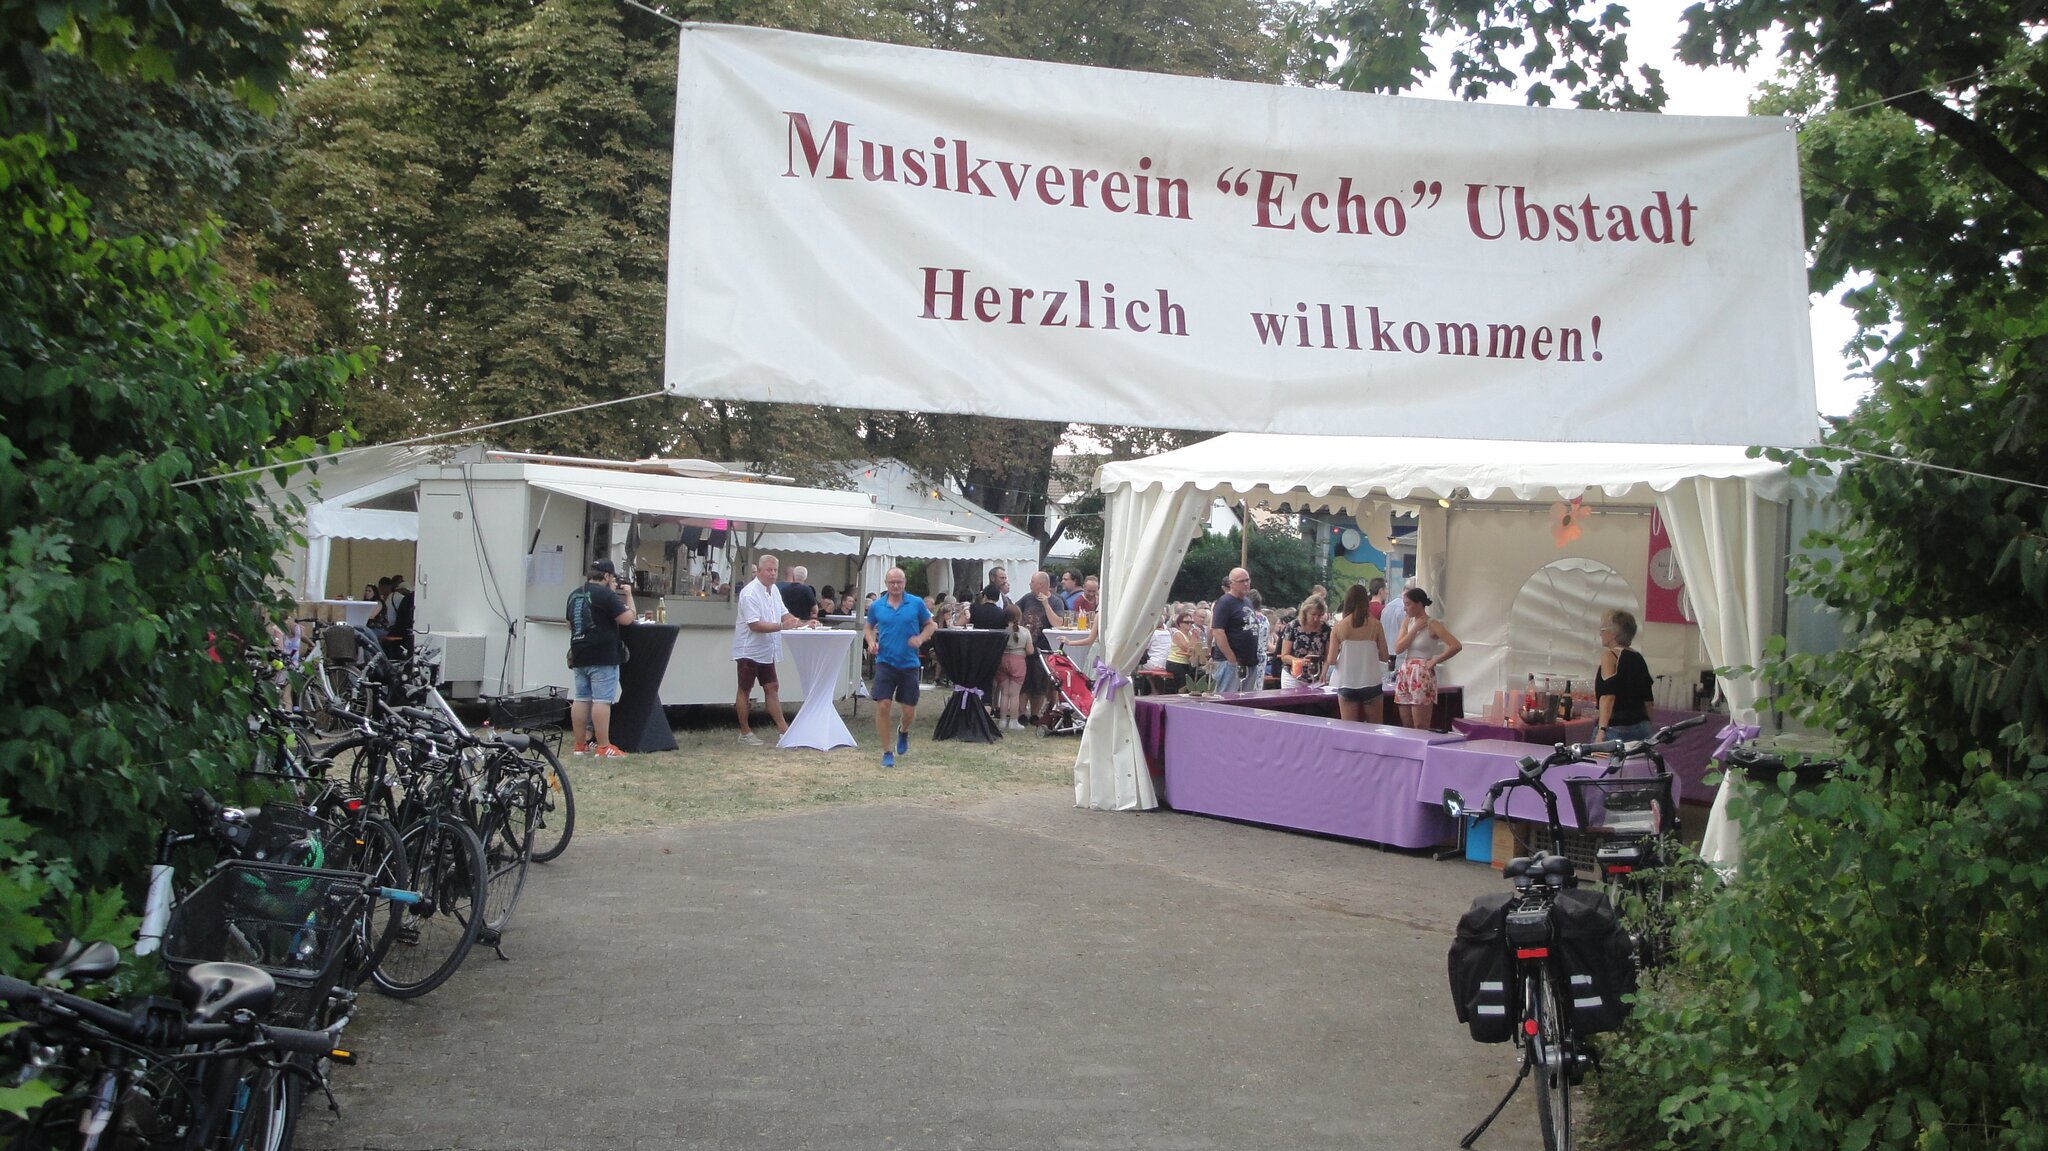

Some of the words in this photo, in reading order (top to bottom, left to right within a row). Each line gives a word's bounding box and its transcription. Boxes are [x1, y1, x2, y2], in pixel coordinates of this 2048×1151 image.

[781, 111, 1192, 220] Musikverein
[1465, 183, 1698, 247] Ubstadt
[917, 267, 1190, 337] Herzlich
[1250, 302, 1603, 362] willkommen!
